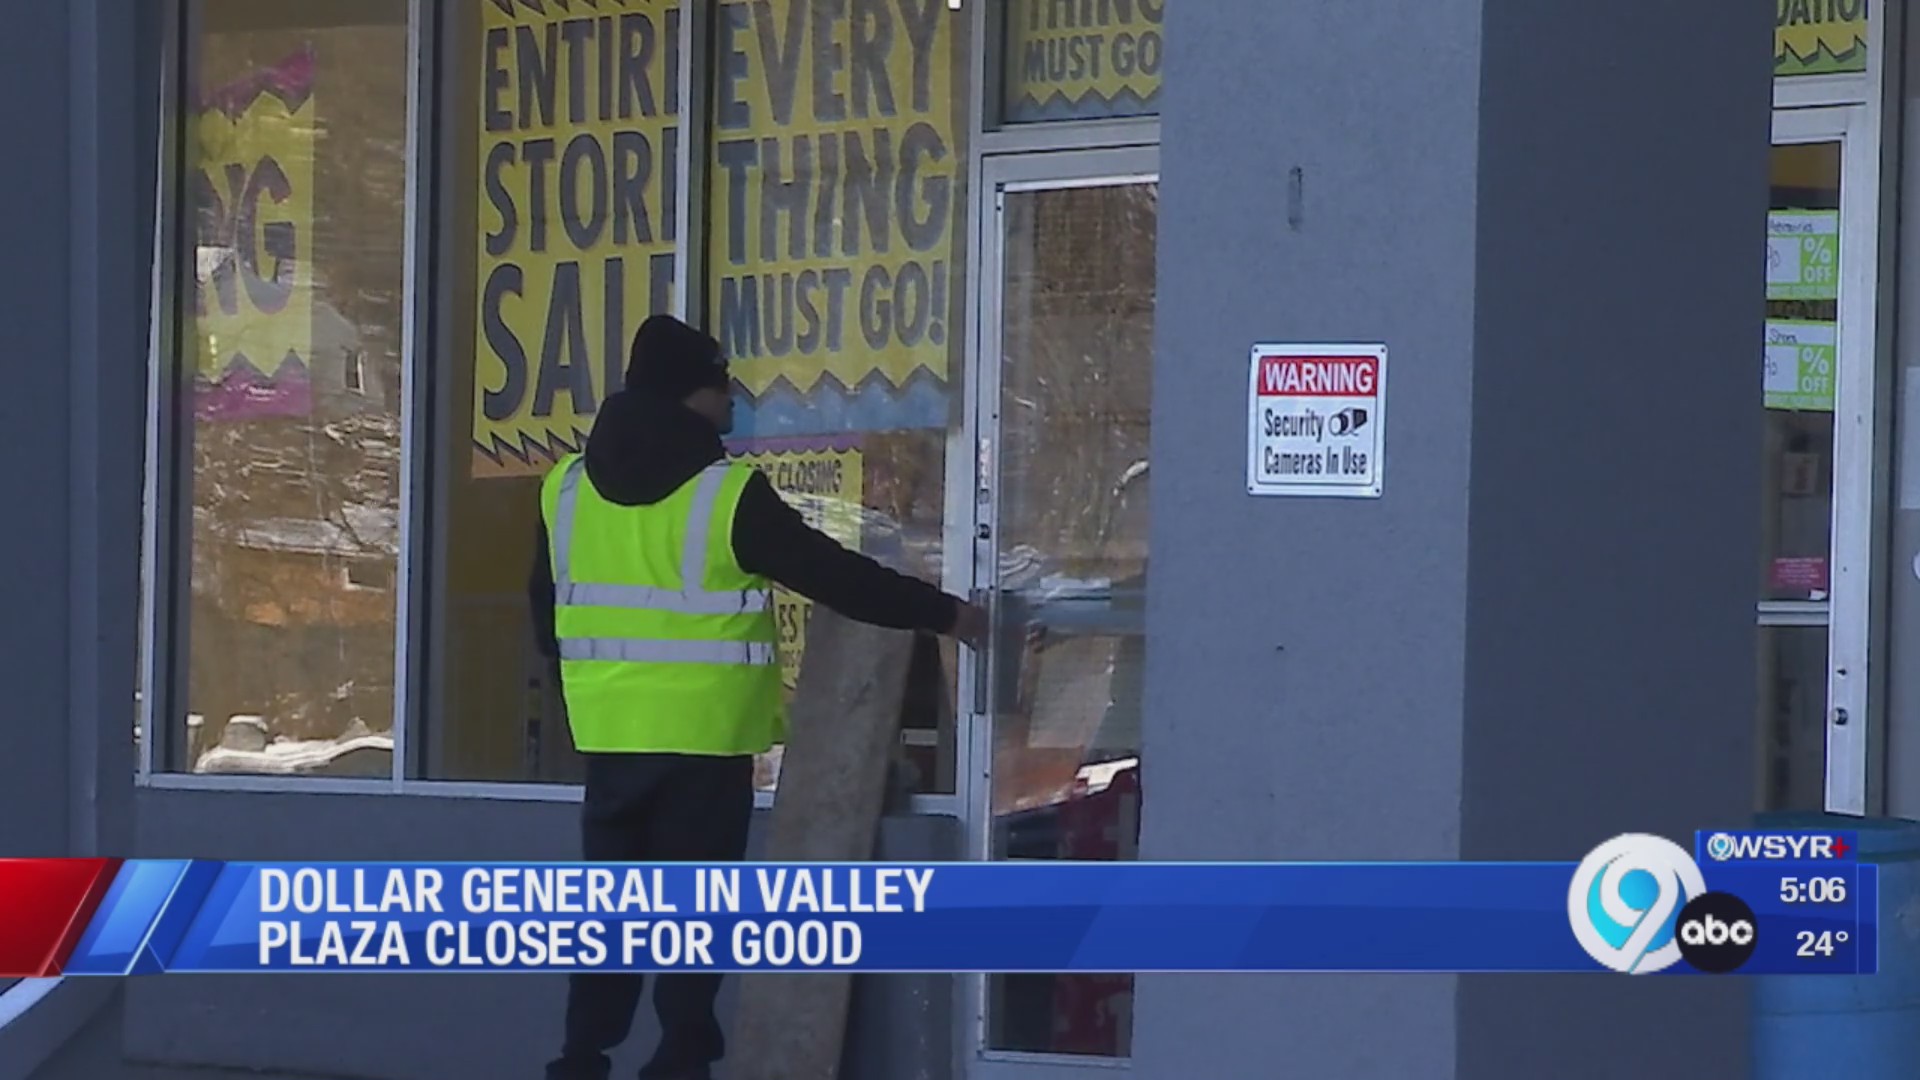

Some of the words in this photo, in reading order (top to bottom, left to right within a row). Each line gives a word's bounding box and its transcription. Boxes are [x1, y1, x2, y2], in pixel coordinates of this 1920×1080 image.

[1777, 0, 1868, 26] ATIO
[717, 0, 942, 130] EVERY
[1024, 33, 1104, 83] MUST
[1111, 30, 1162, 77] GO
[718, 121, 949, 265] THING
[1804, 265, 1832, 283] OFF
[719, 267, 851, 358] MUST
[859, 260, 946, 351] GO!
[1265, 361, 1373, 393] WARNING
[1801, 375, 1829, 394] OFF
[1265, 408, 1324, 443] Security
[777, 459, 842, 494] CLOSING
[1264, 446, 1322, 475] Cameras
[1326, 446, 1339, 474] In
[1343, 446, 1367, 475] Use
